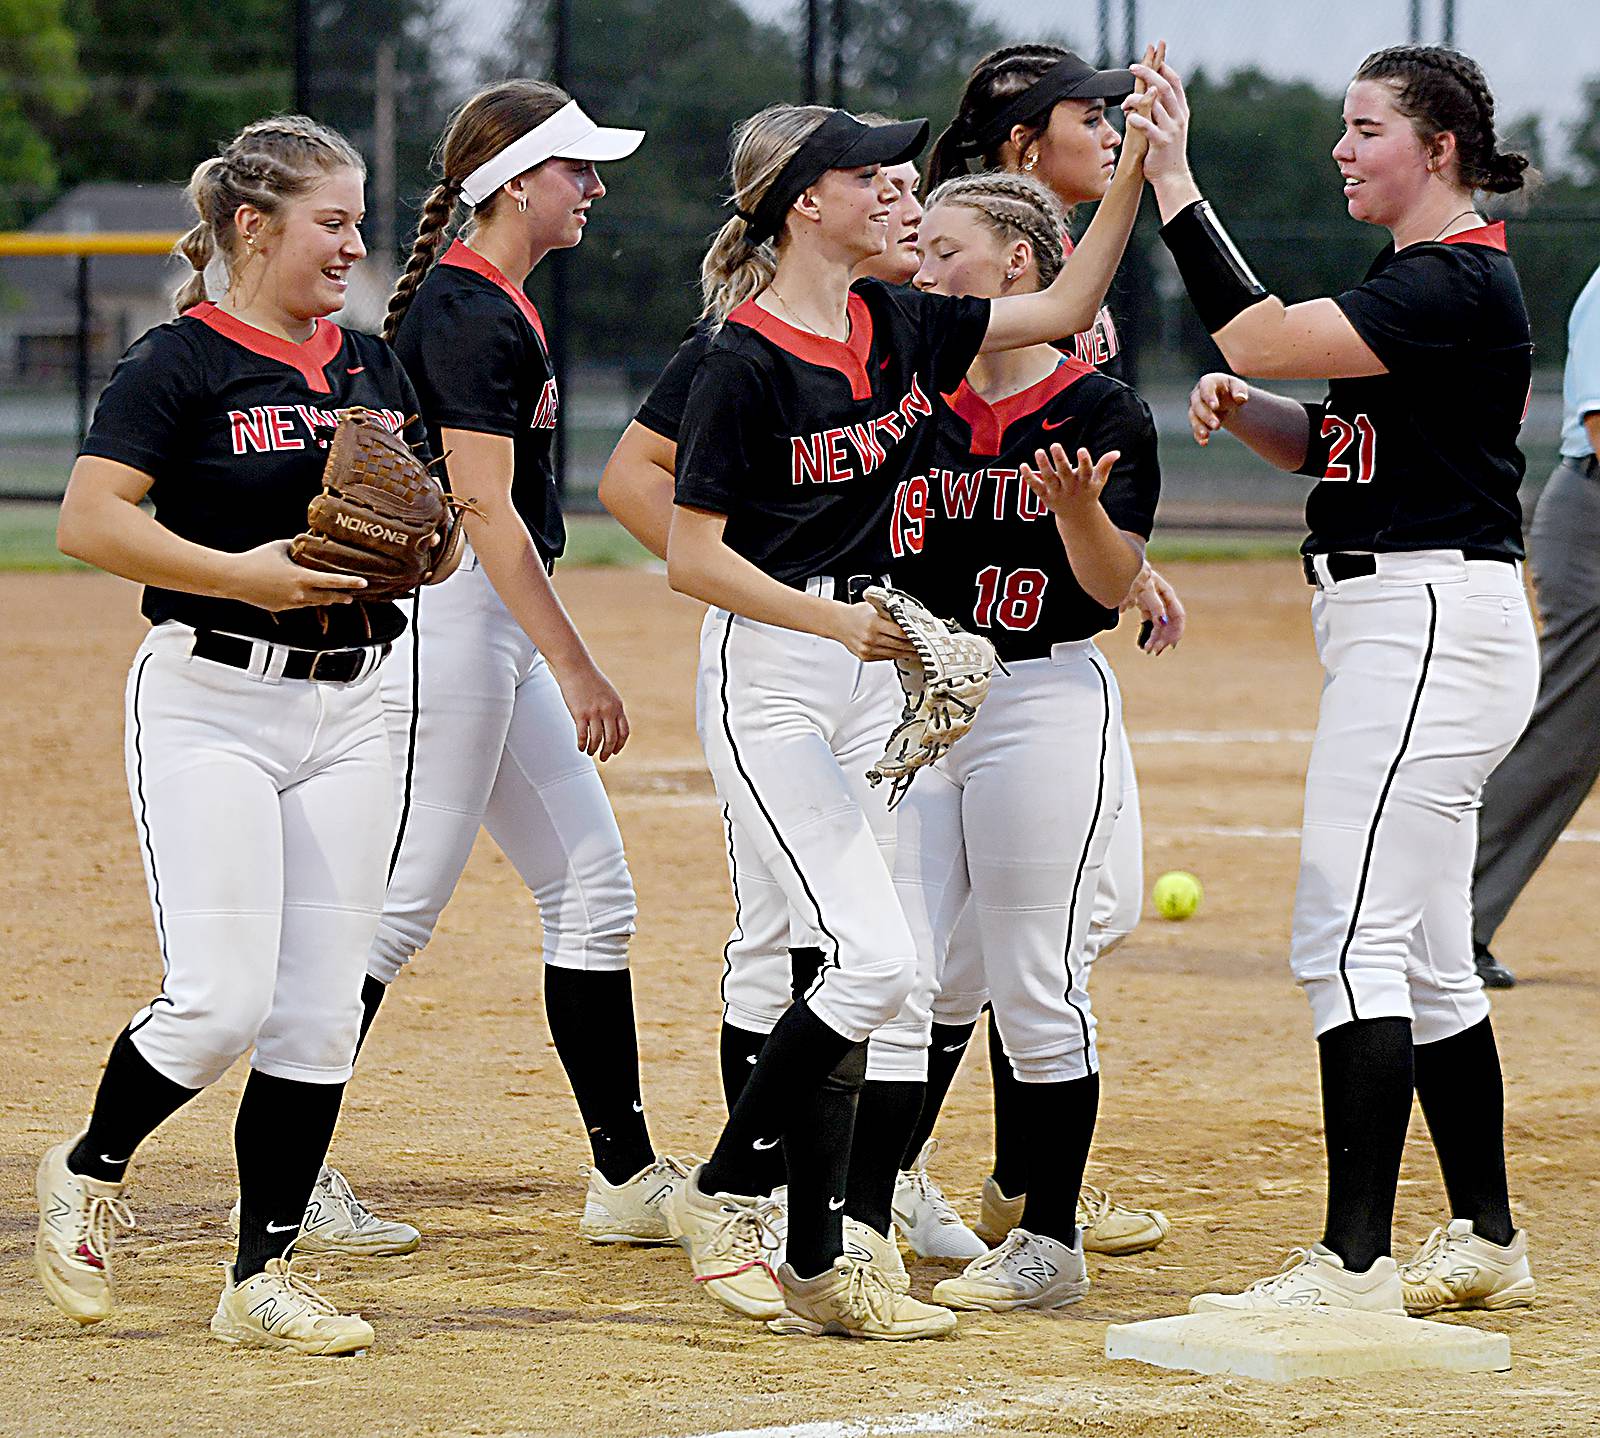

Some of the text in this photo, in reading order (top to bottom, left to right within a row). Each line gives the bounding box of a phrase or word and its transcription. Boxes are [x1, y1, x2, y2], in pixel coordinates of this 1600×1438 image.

[790, 371, 933, 485] NEWTN
[1320, 413, 1377, 484] 21
[889, 475, 930, 558] 19
[973, 565, 1049, 632] 18
